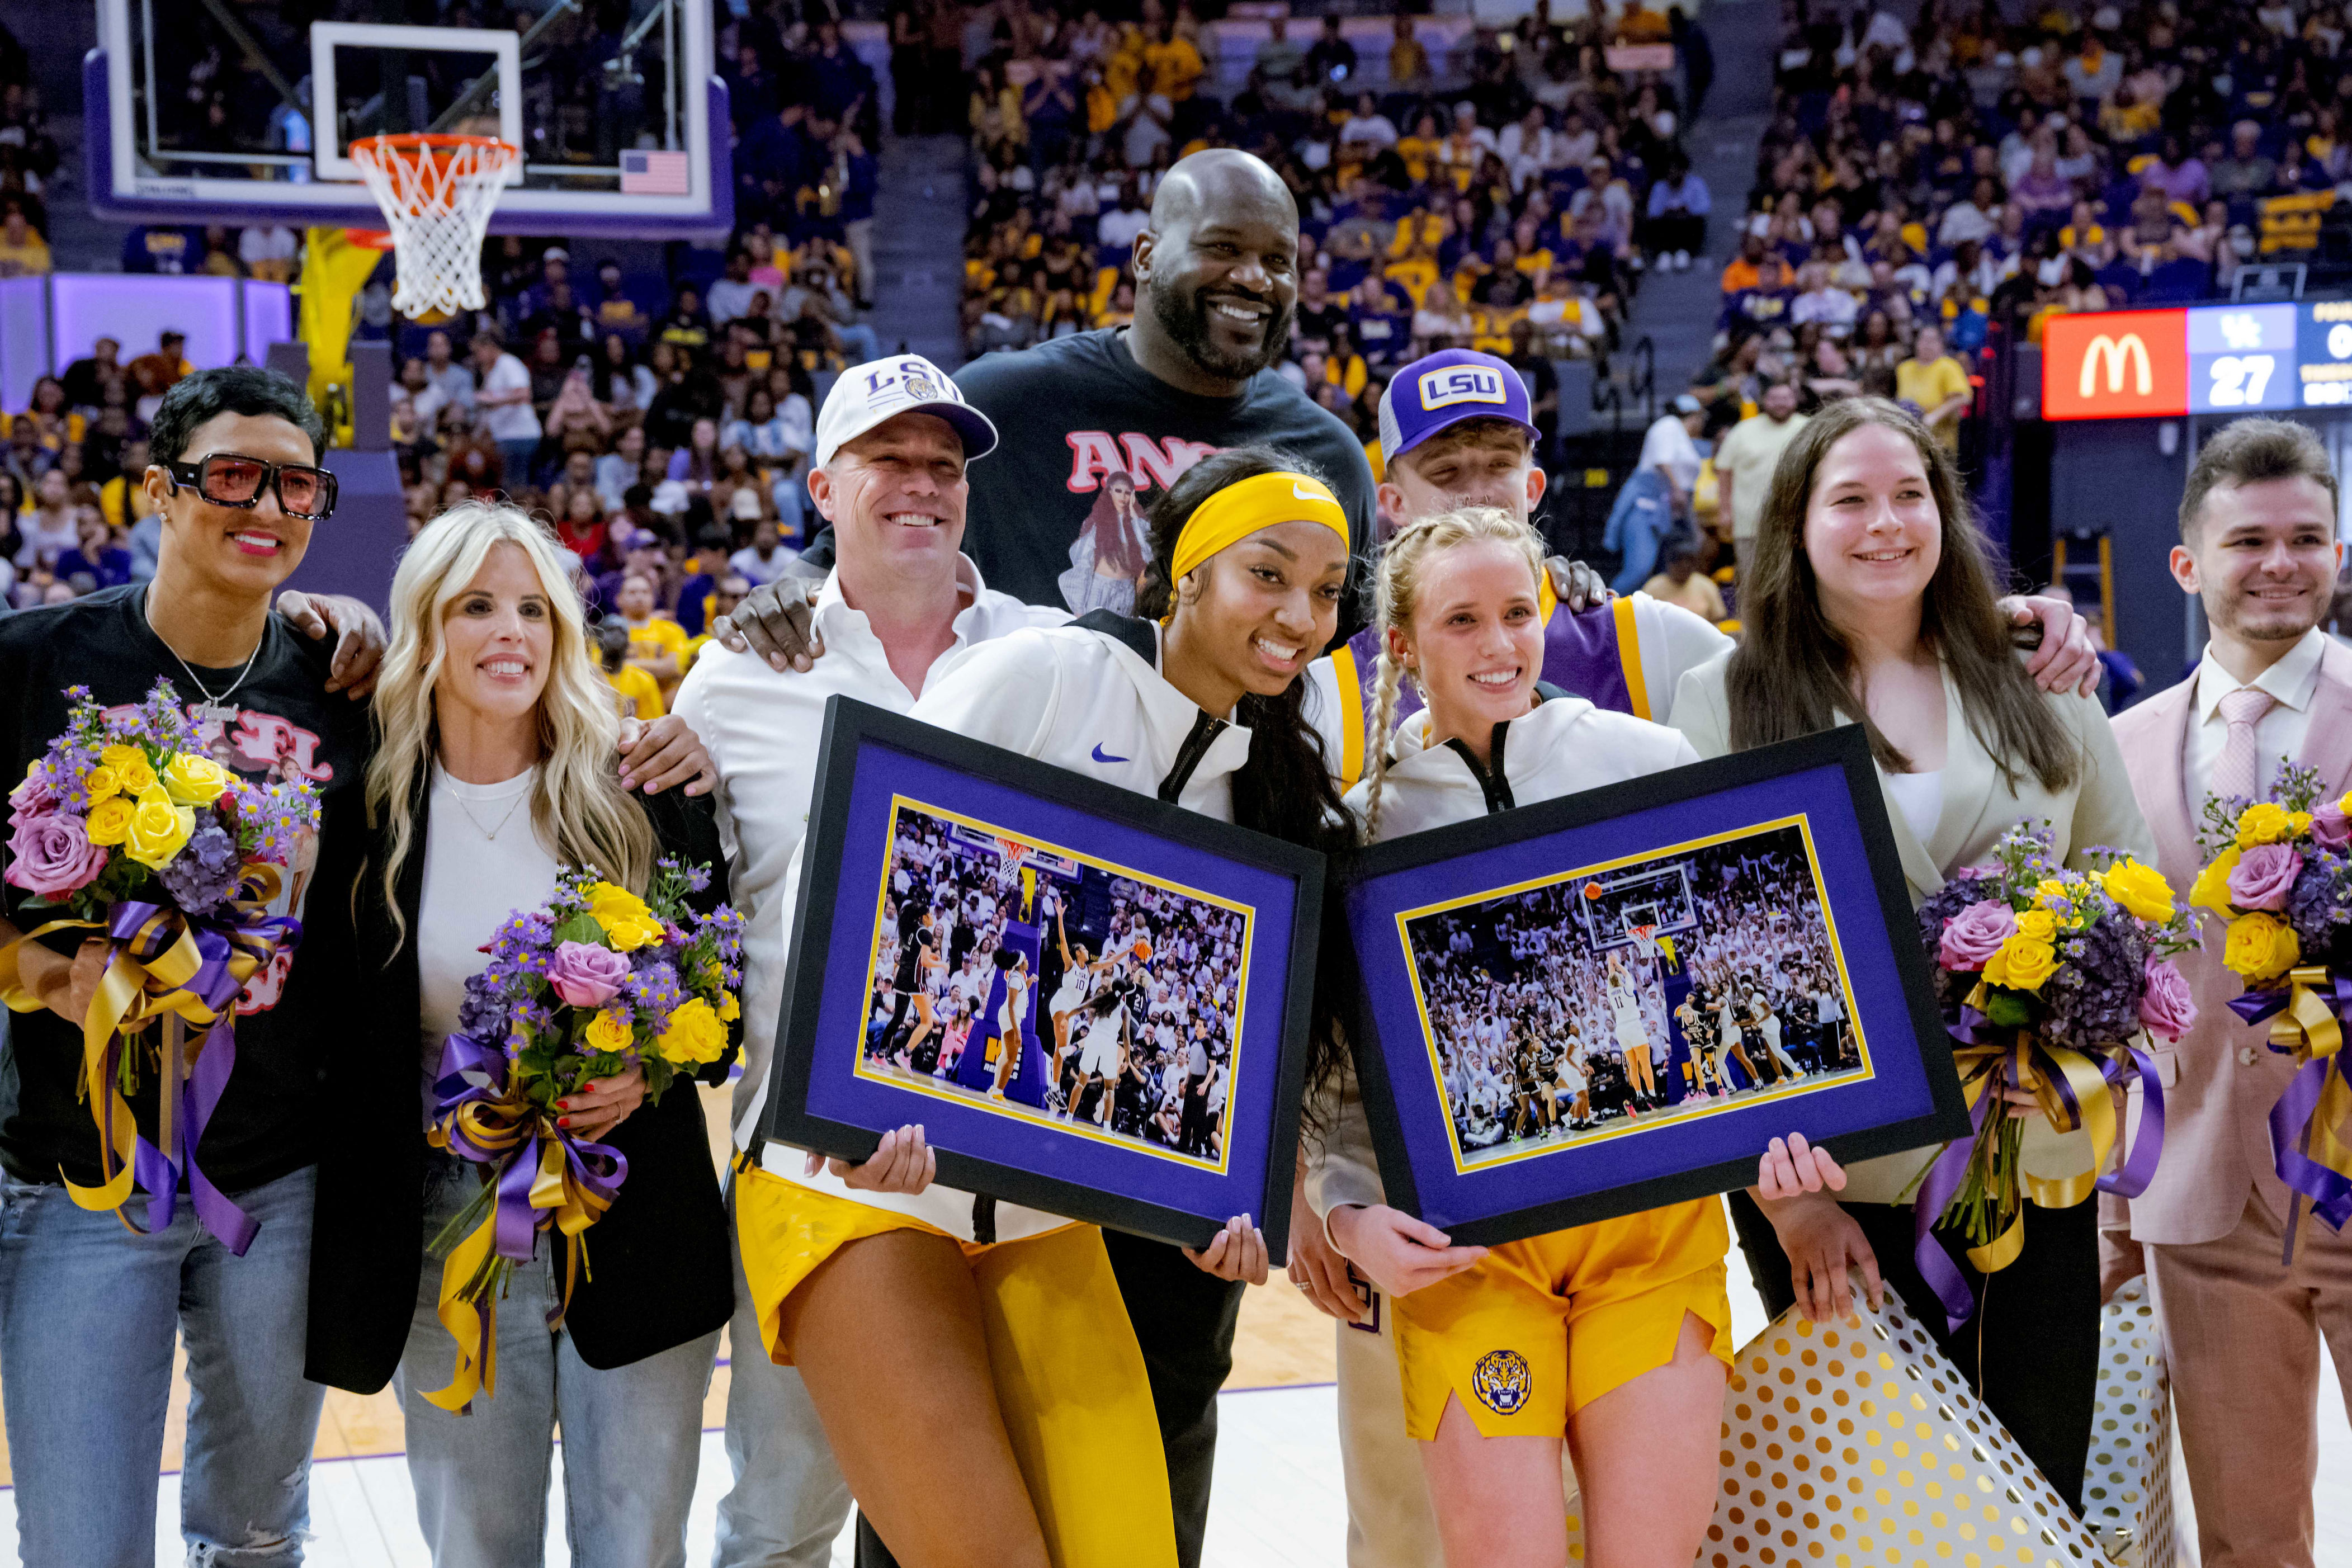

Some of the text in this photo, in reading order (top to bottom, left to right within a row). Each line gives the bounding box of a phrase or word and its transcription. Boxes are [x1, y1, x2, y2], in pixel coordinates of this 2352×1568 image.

[865, 362, 959, 402] LSU
[1428, 374, 1496, 400] LSU
[2209, 355, 2275, 406] 27
[1075, 978, 1085, 991] 10
[1134, 993, 1144, 1009] 21
